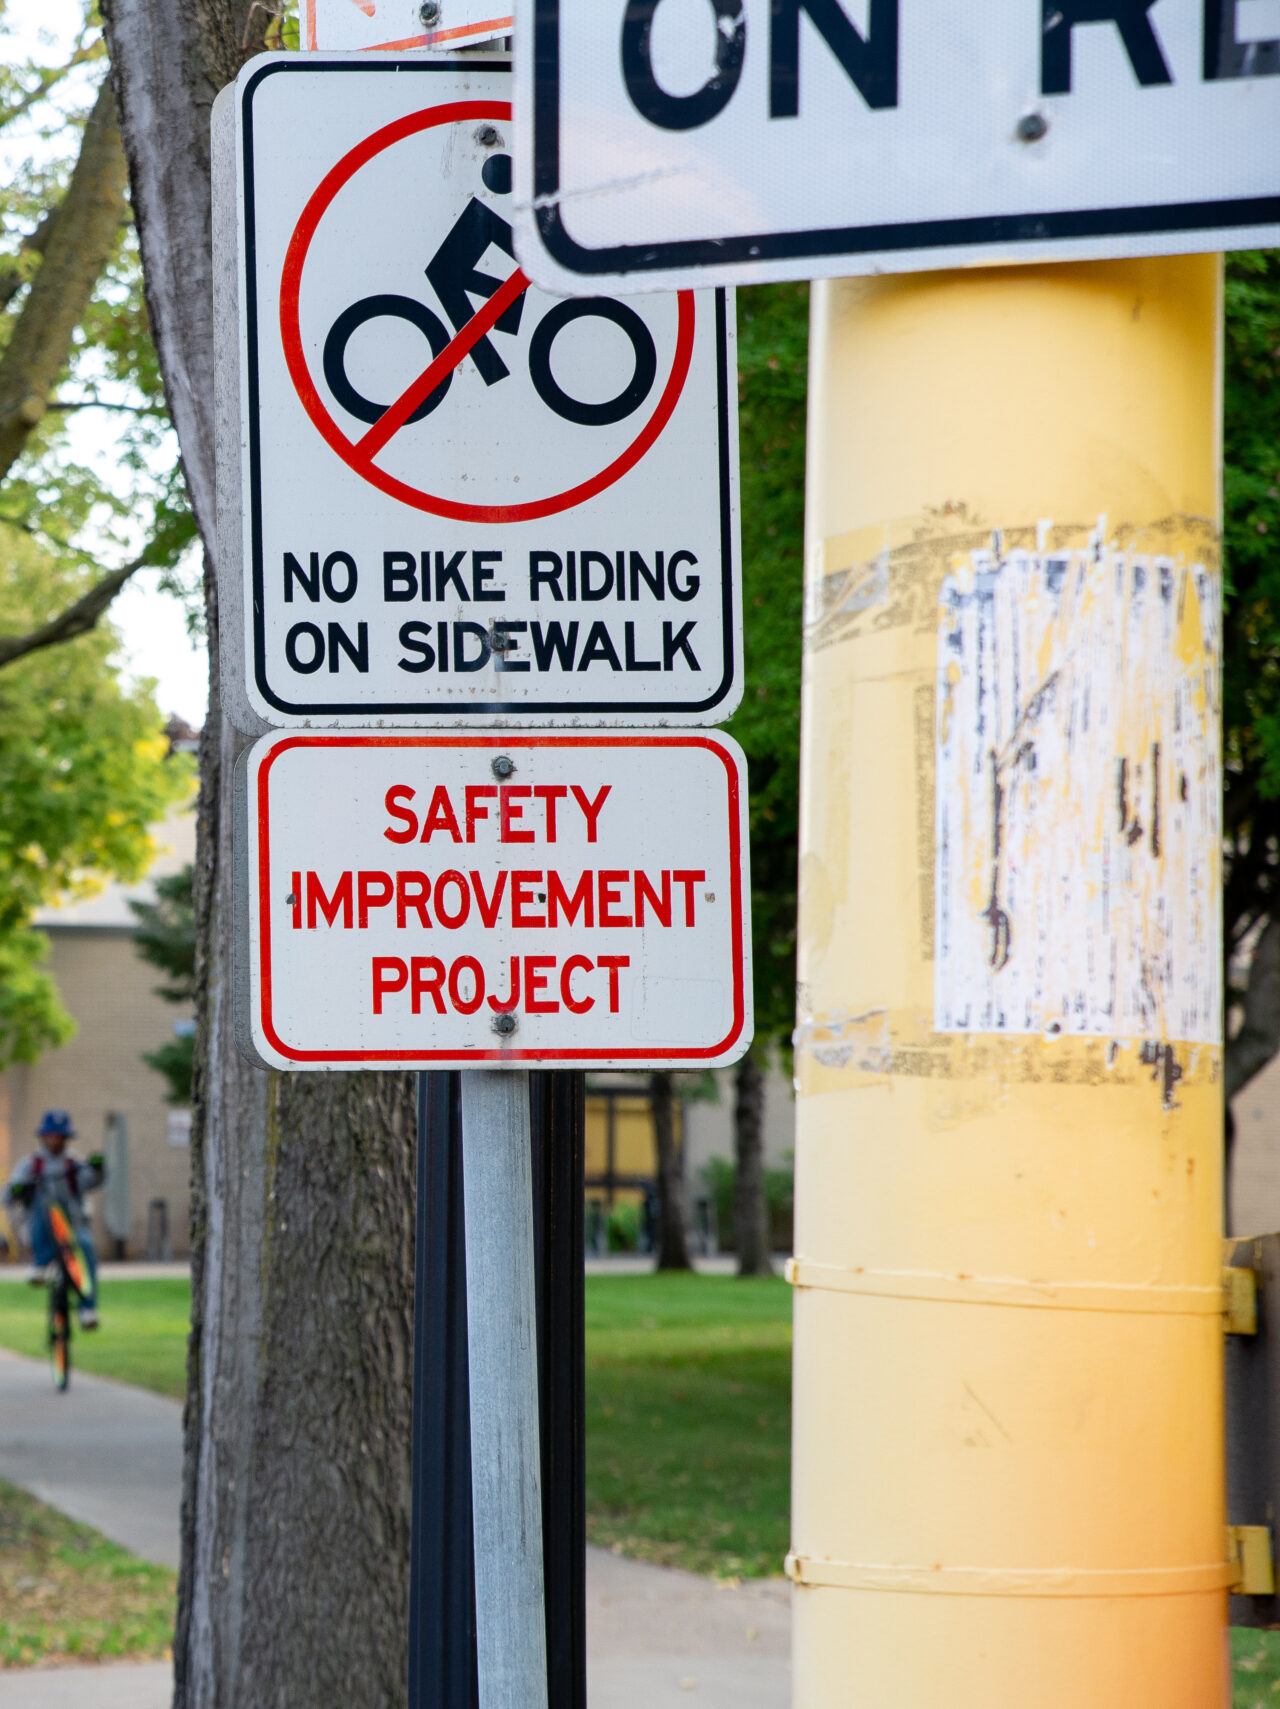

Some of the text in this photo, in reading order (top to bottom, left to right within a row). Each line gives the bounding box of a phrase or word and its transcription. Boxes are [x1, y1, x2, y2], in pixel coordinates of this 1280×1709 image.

[620, 0, 900, 132] ON
[283, 550, 700, 603] NO BIKE RIDING
[285, 621, 701, 674] ON SIDEWALK
[383, 784, 613, 845] SAFETY
[291, 869, 706, 929] IMPROVEMENT
[371, 954, 630, 1015] PROJECT
